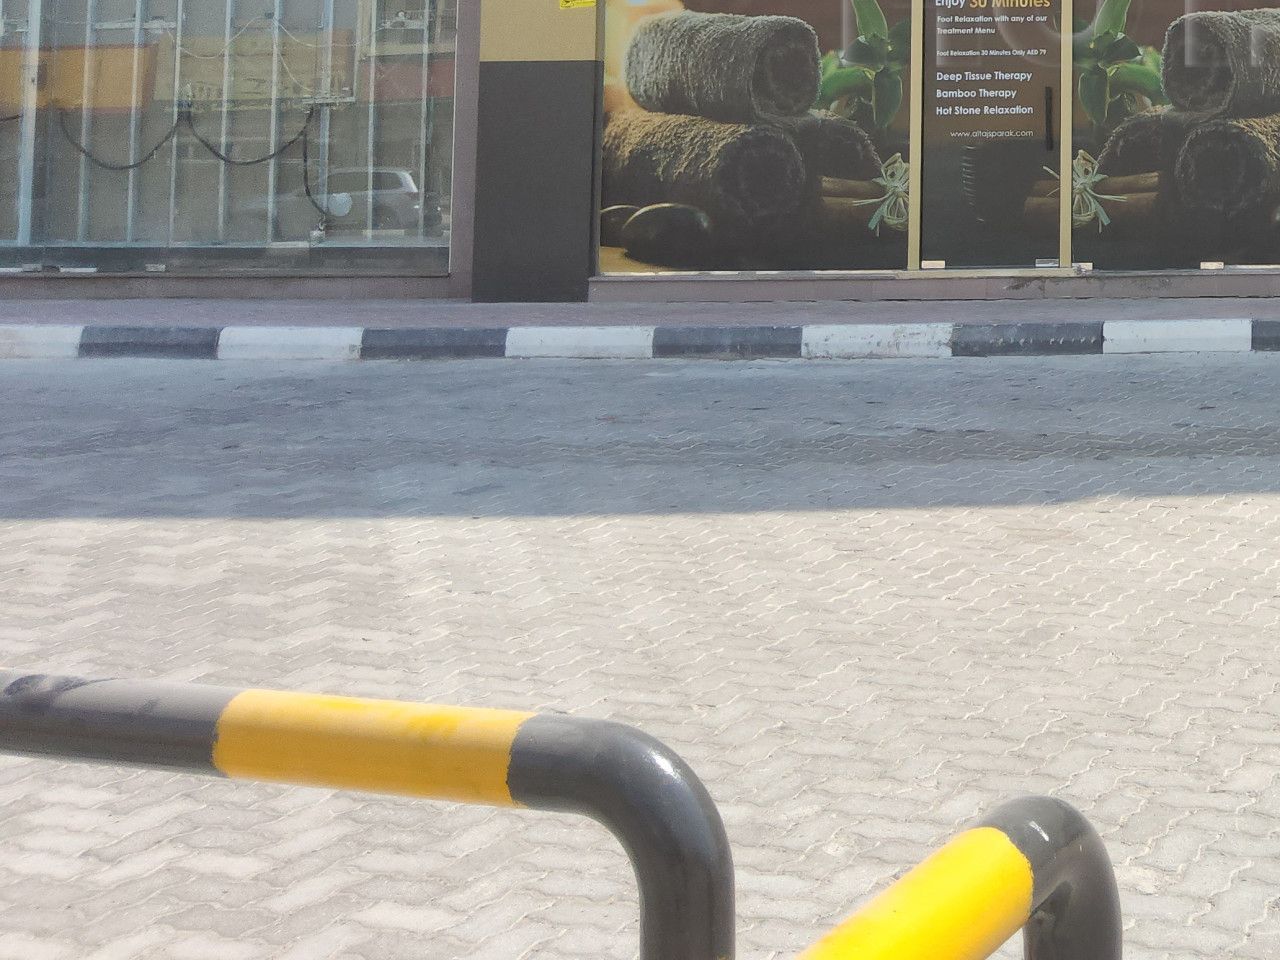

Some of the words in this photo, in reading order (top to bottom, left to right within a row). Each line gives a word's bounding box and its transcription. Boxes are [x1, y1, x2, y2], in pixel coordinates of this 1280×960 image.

[1012, 49, 1025, 57] Only
[936, 72, 962, 82] Deep
[964, 71, 992, 80] Tissue
[994, 71, 1033, 82] Therapy
[936, 89, 976, 98] Bamboo
[979, 88, 1017, 99] Therapy
[936, 106, 952, 115] Hot
[954, 105, 980, 115] Stone
[983, 105, 1034, 114] Relaxation
